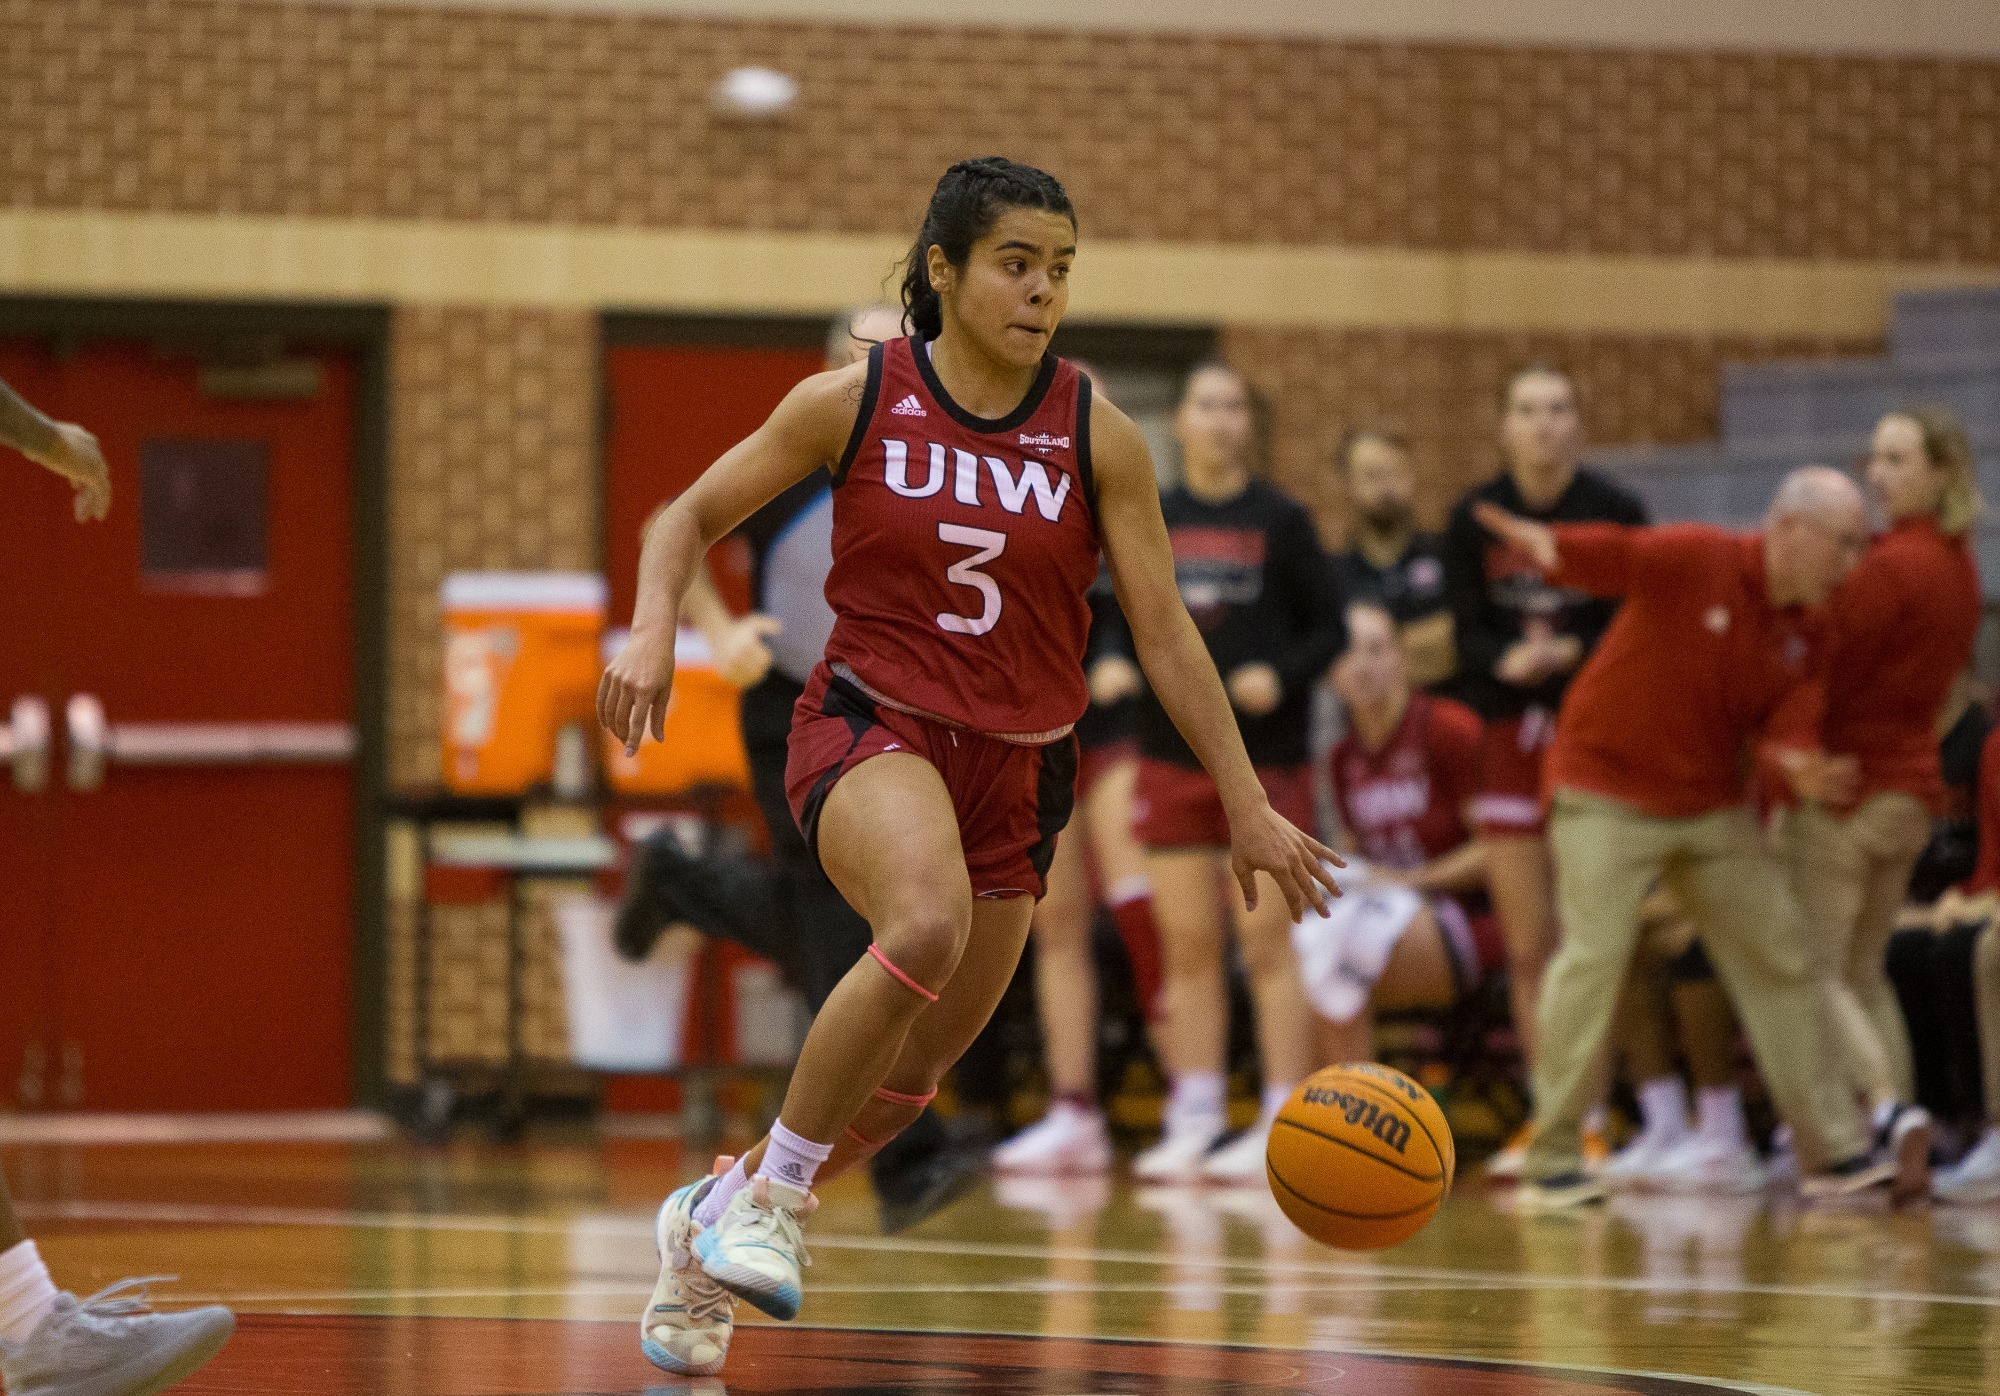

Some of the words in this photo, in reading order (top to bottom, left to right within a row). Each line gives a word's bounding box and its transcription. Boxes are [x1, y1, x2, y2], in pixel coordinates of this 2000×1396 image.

[891, 407, 927, 417] adidas
[1019, 433, 1070, 449] SOUTHLAND
[880, 438, 1071, 523] UIW
[936, 521, 1007, 636] 3
[1303, 1086, 1412, 1154] Wilson
